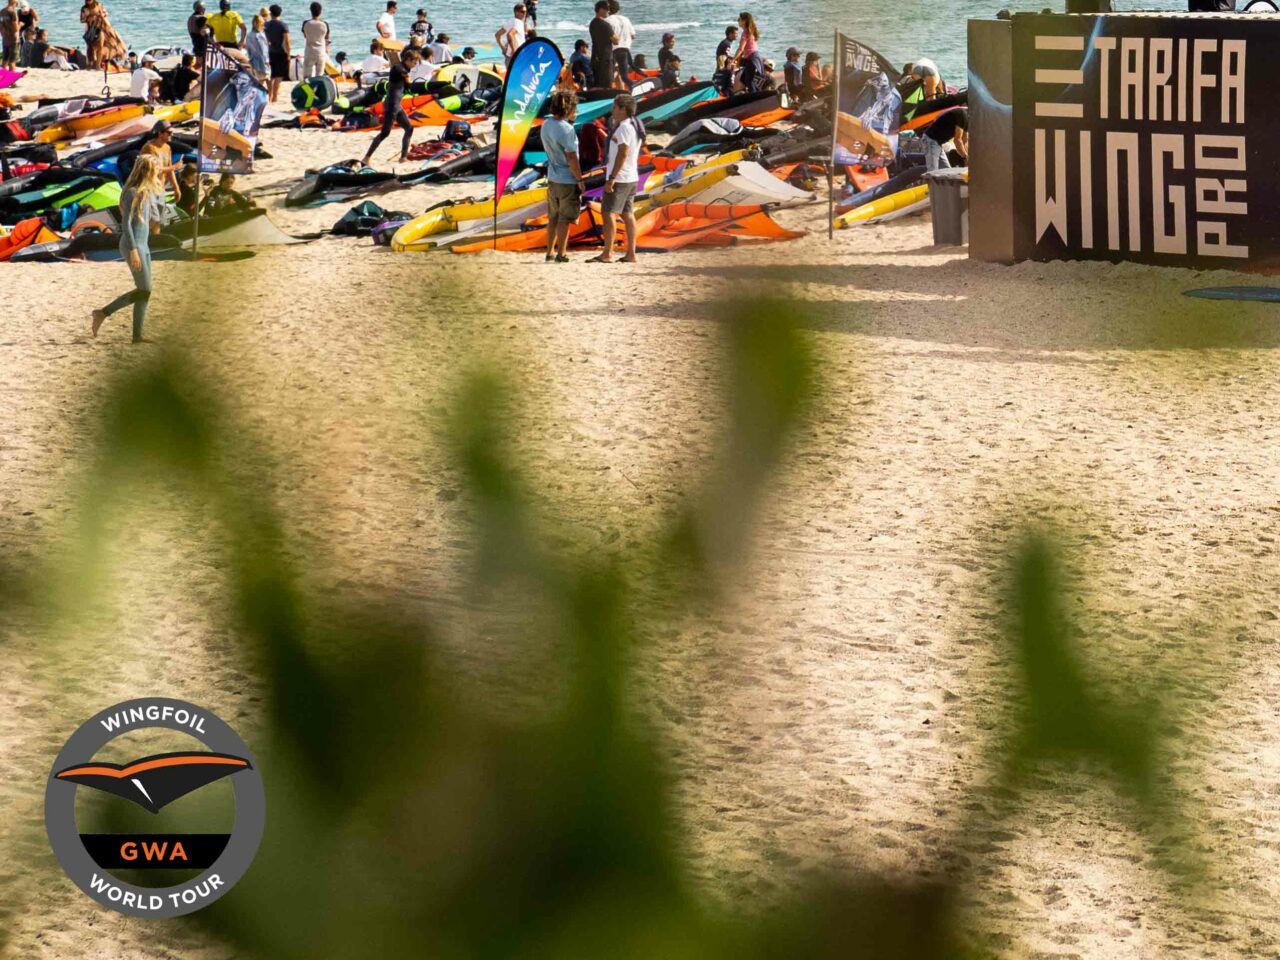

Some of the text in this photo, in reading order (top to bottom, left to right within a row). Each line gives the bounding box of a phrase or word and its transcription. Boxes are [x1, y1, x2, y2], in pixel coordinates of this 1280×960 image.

[1094, 37, 1247, 124] TARIFA
[1035, 128, 1249, 258] WING PRO
